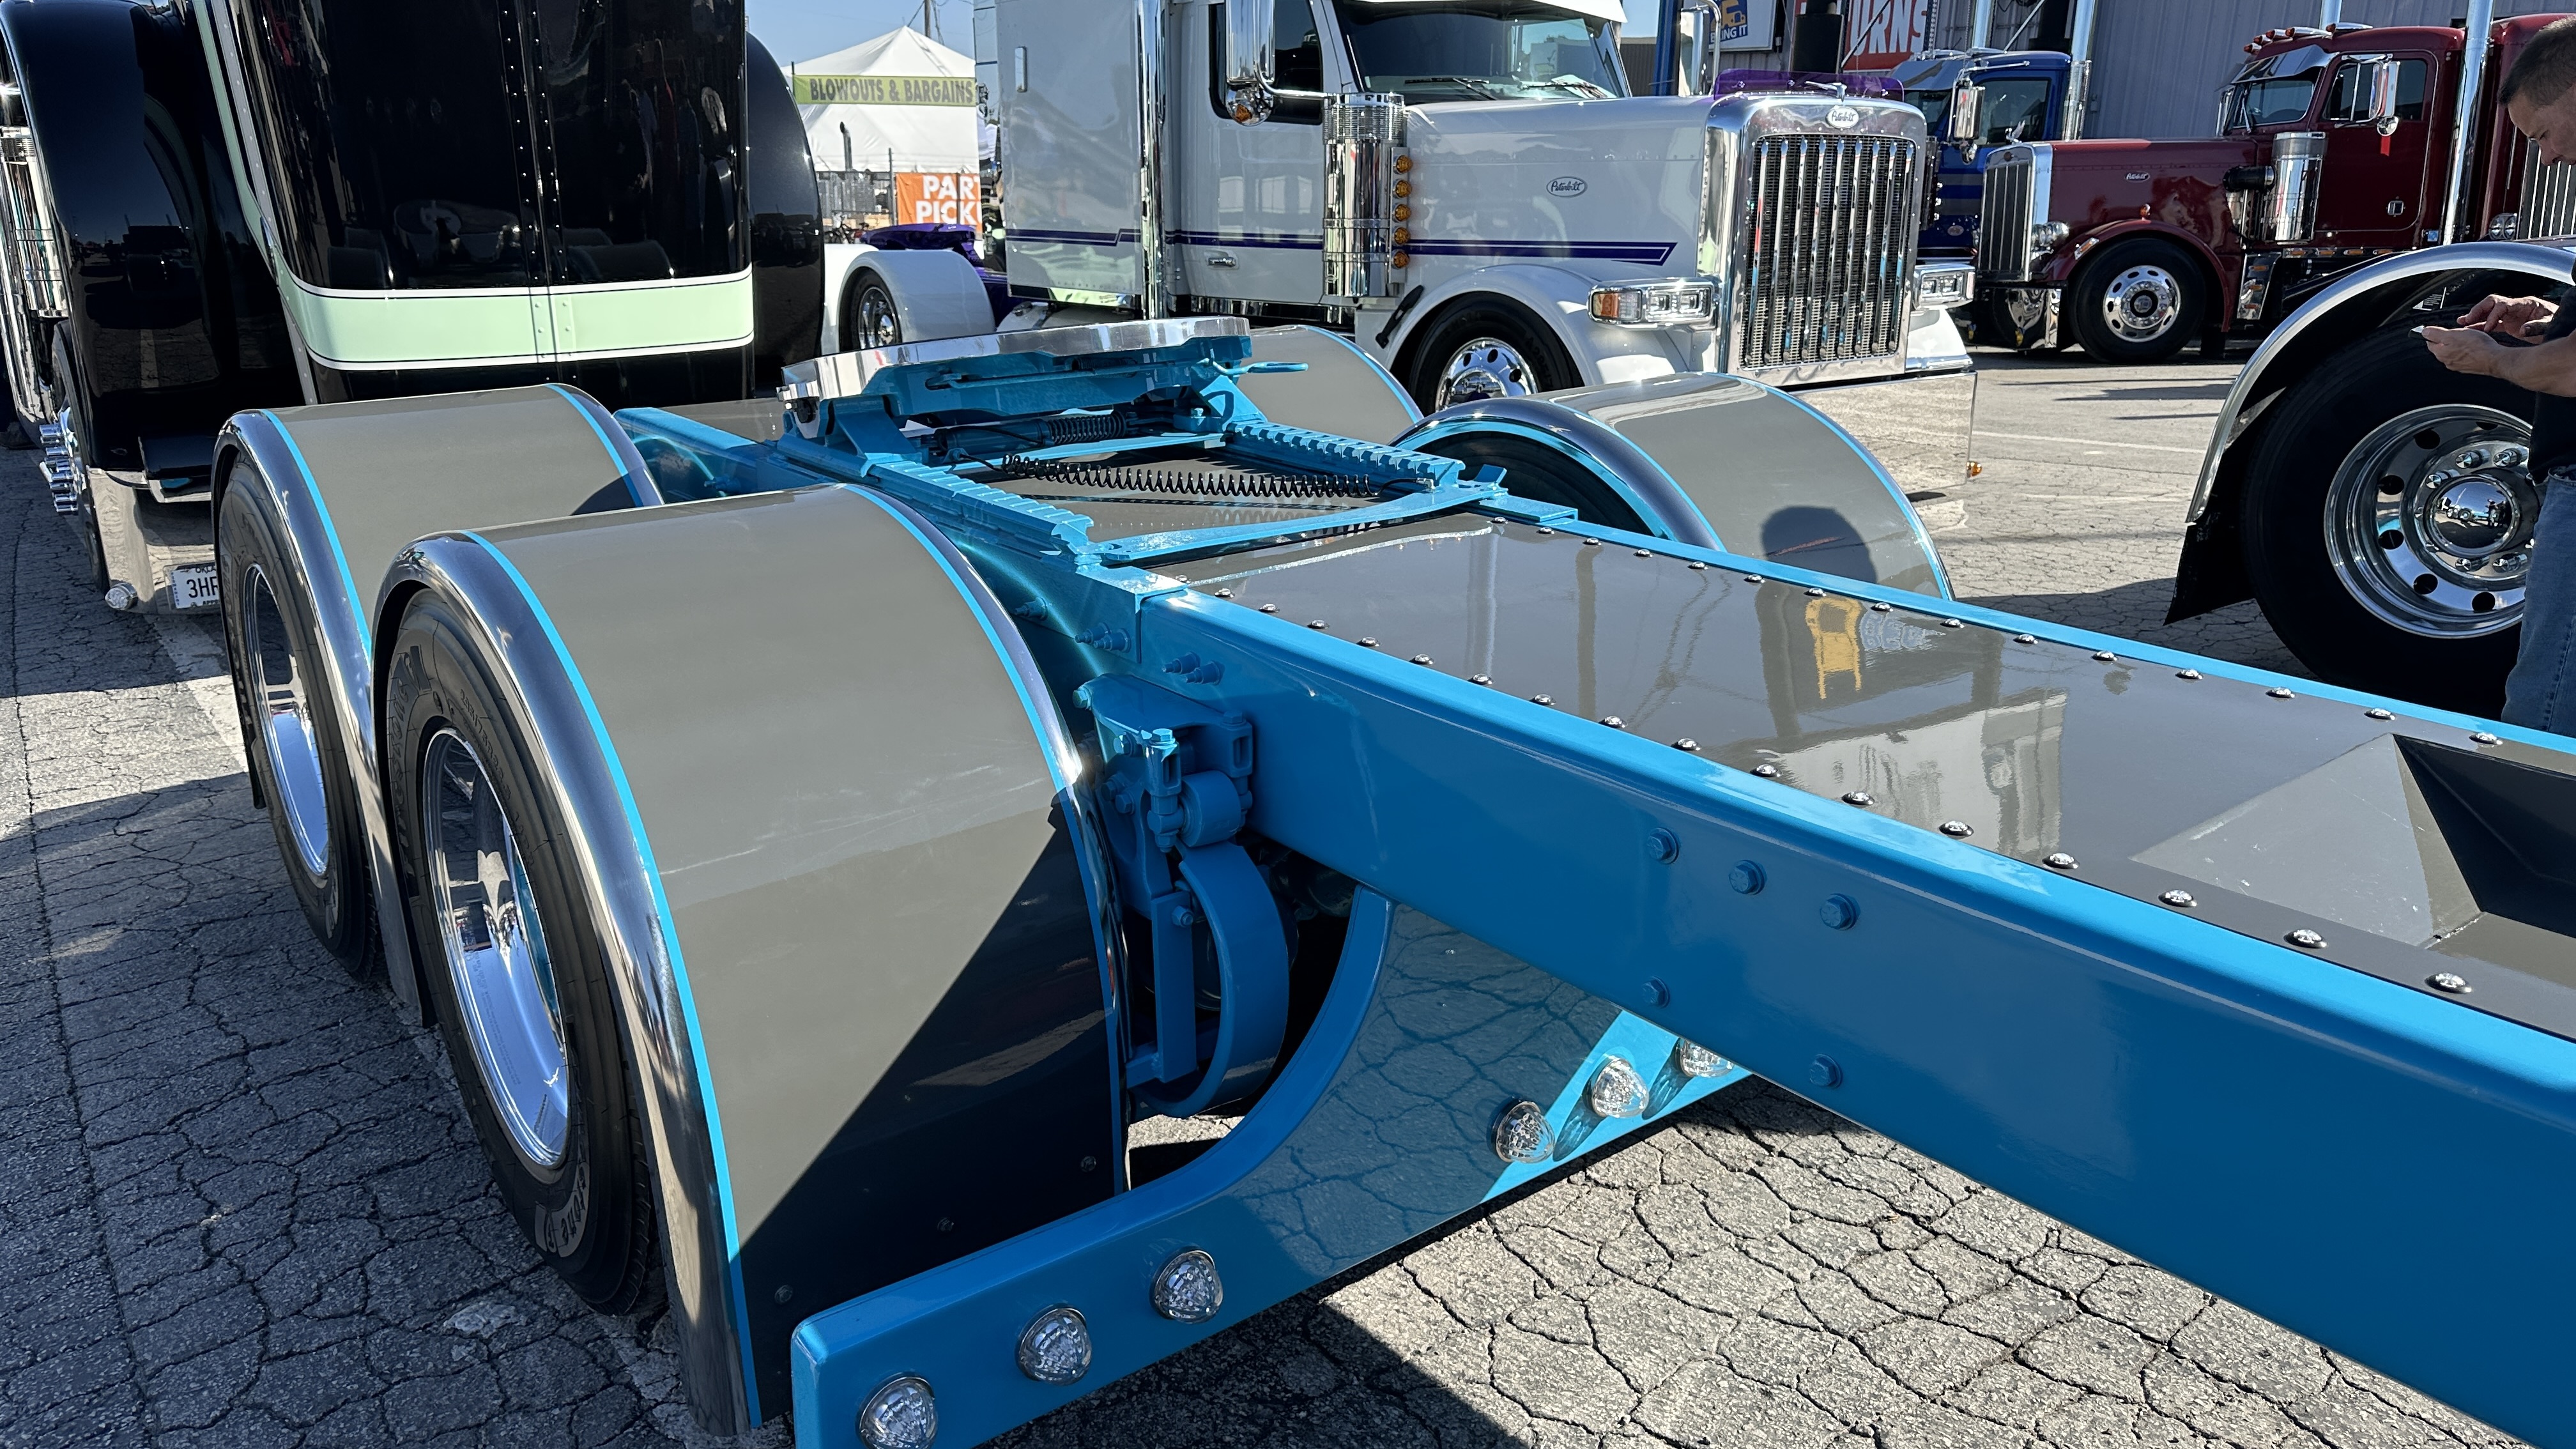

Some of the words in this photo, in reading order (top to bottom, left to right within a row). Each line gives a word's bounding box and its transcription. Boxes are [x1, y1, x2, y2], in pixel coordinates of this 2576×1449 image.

[1710, 27, 1737, 43] BING
[1739, 24, 1747, 36] IT
[809, 78, 884, 101] BLOWOUTS
[889, 79, 900, 102] &
[903, 79, 973, 103] BARGAINS
[1551, 180, 1583, 192] Peterbilt
